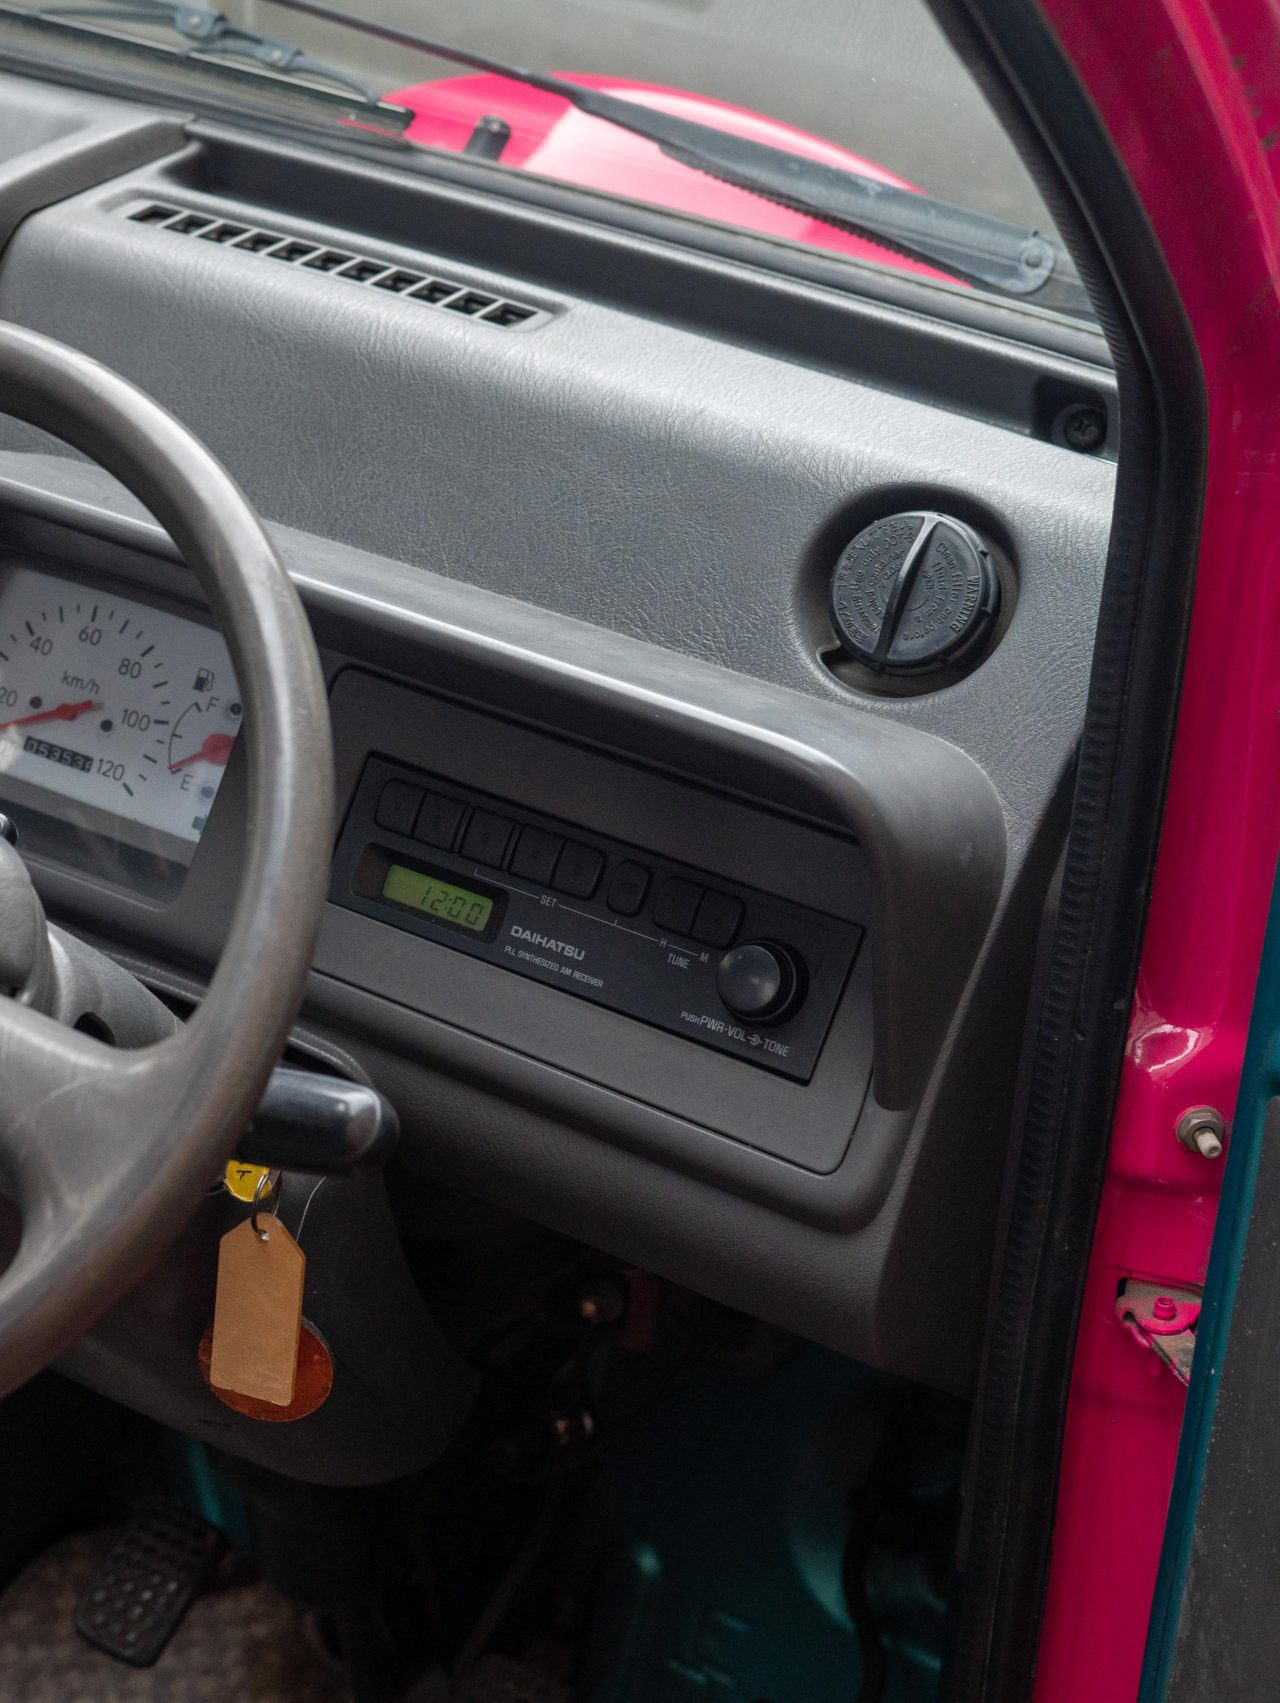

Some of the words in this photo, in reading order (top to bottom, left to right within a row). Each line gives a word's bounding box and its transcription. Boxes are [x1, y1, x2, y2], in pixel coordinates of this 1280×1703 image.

[936, 542, 956, 569] Clean
[950, 575, 979, 633] WARNING
[29, 636, 53, 656] 40
[79, 627, 102, 645] 60
[118, 658, 142, 679] 80
[61, 670, 100, 695] km/h
[205, 697, 219, 713] F
[121, 708, 151, 731] 100
[97, 757, 125, 781] 120
[180, 774, 194, 791] E
[420, 885, 485, 927] 12:00
[539, 894, 558, 908] SET
[510, 925, 586, 961] DAIHATSU
[660, 938, 668, 948] H
[699, 952, 710, 963] M
[504, 945, 516, 957] PLL
[517, 950, 560, 972] SYNTHESIZED
[560, 965, 572, 977] AM
[572, 971, 604, 989] RECEIVER
[668, 953, 690, 969] TUNE
[681, 1010, 700, 1025] PUSH
[763, 1038, 790, 1057] TONE
